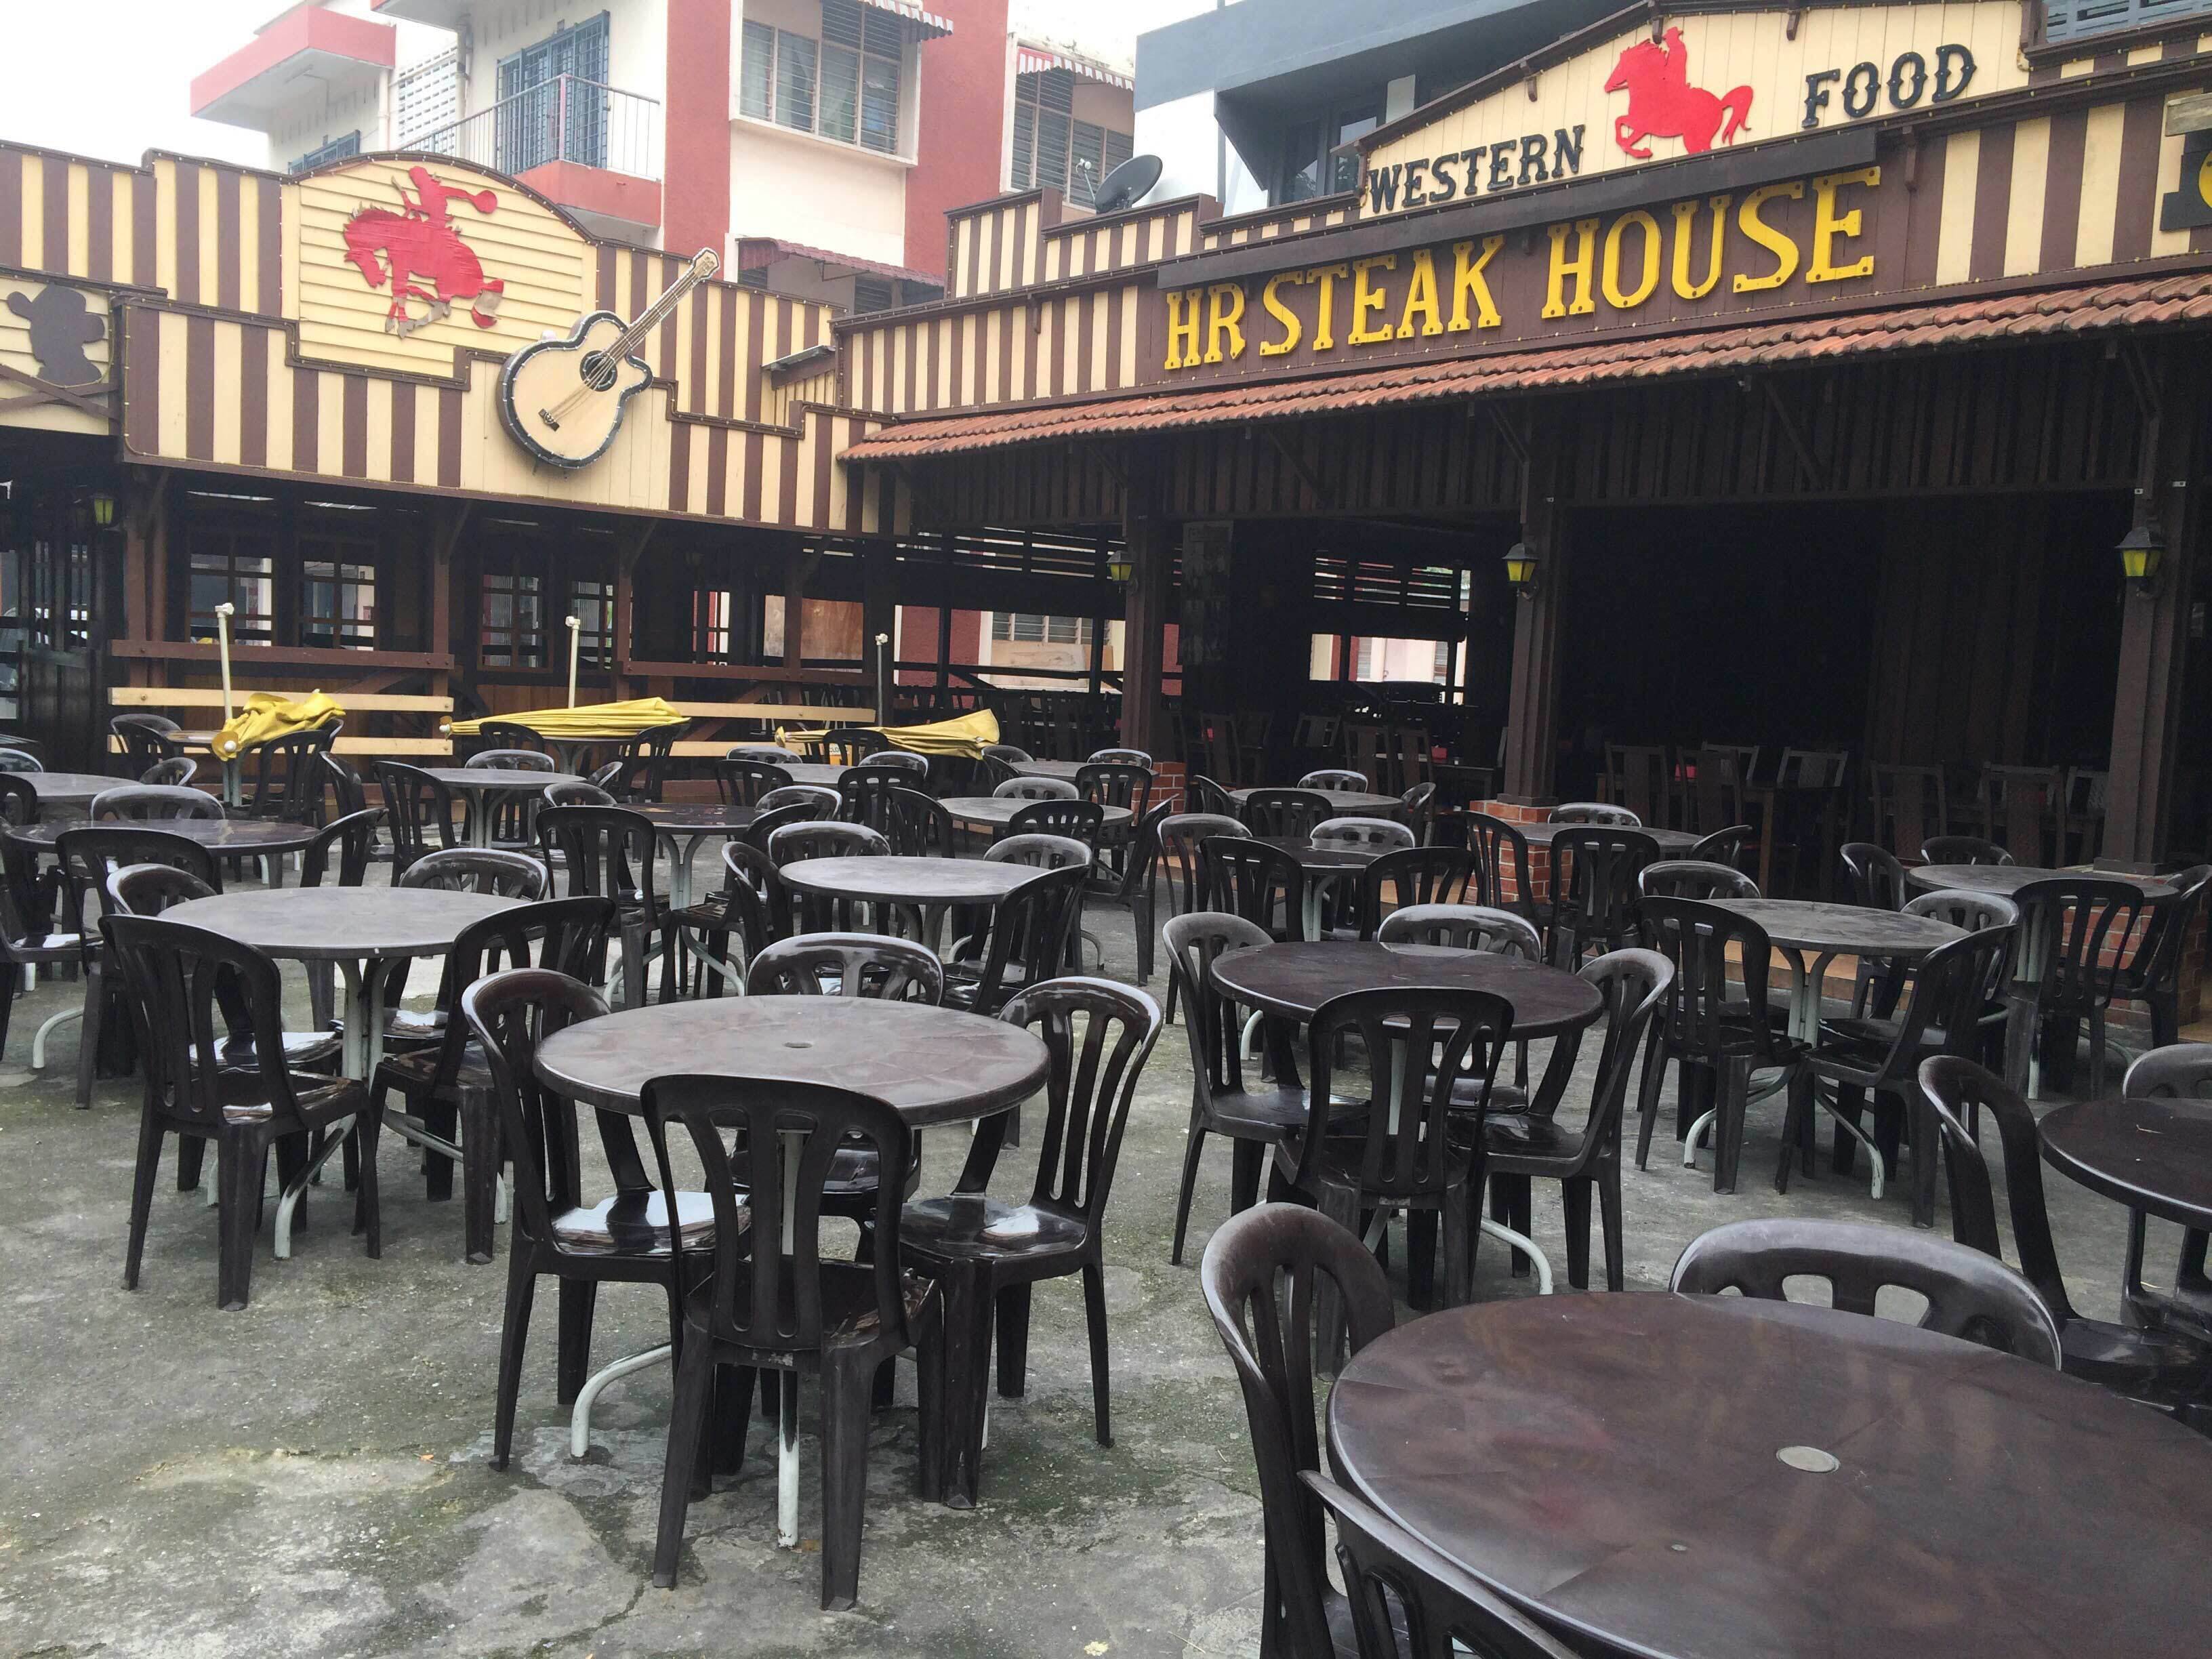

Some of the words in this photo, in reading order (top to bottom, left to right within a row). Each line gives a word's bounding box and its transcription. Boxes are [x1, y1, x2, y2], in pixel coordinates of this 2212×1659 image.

[1368, 124, 1585, 213] WESTERN
[1802, 43, 1978, 128] FOOD
[1164, 282, 1246, 369] HR
[1259, 234, 1505, 356] STEAK
[1540, 166, 1880, 319] HOUSE
